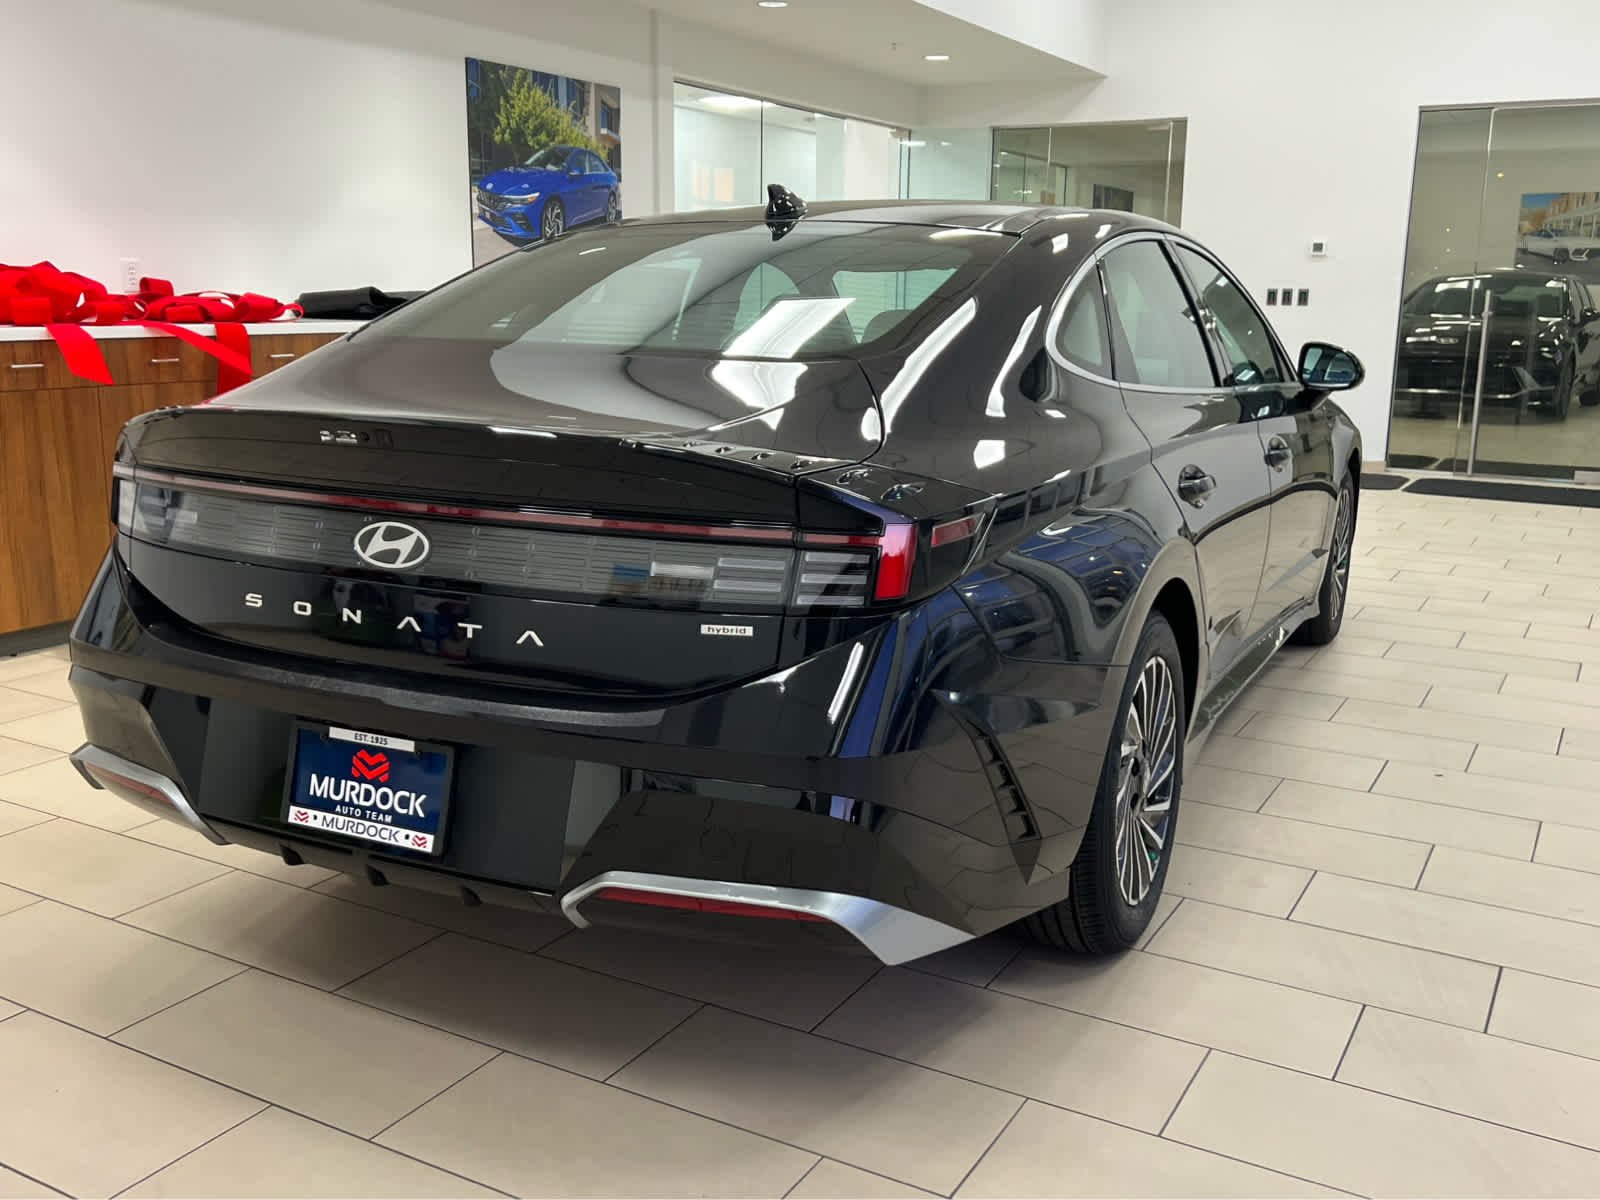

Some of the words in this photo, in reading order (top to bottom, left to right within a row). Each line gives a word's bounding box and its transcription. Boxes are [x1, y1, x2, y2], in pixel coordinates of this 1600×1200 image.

[244, 592, 544, 647] SONATA
[707, 625, 747, 635] hybrid
[309, 773, 427, 818] MURDOCK
[335, 804, 361, 817] AUTO
[365, 810, 392, 824] TEAM
[321, 815, 400, 842] MURDOCK
